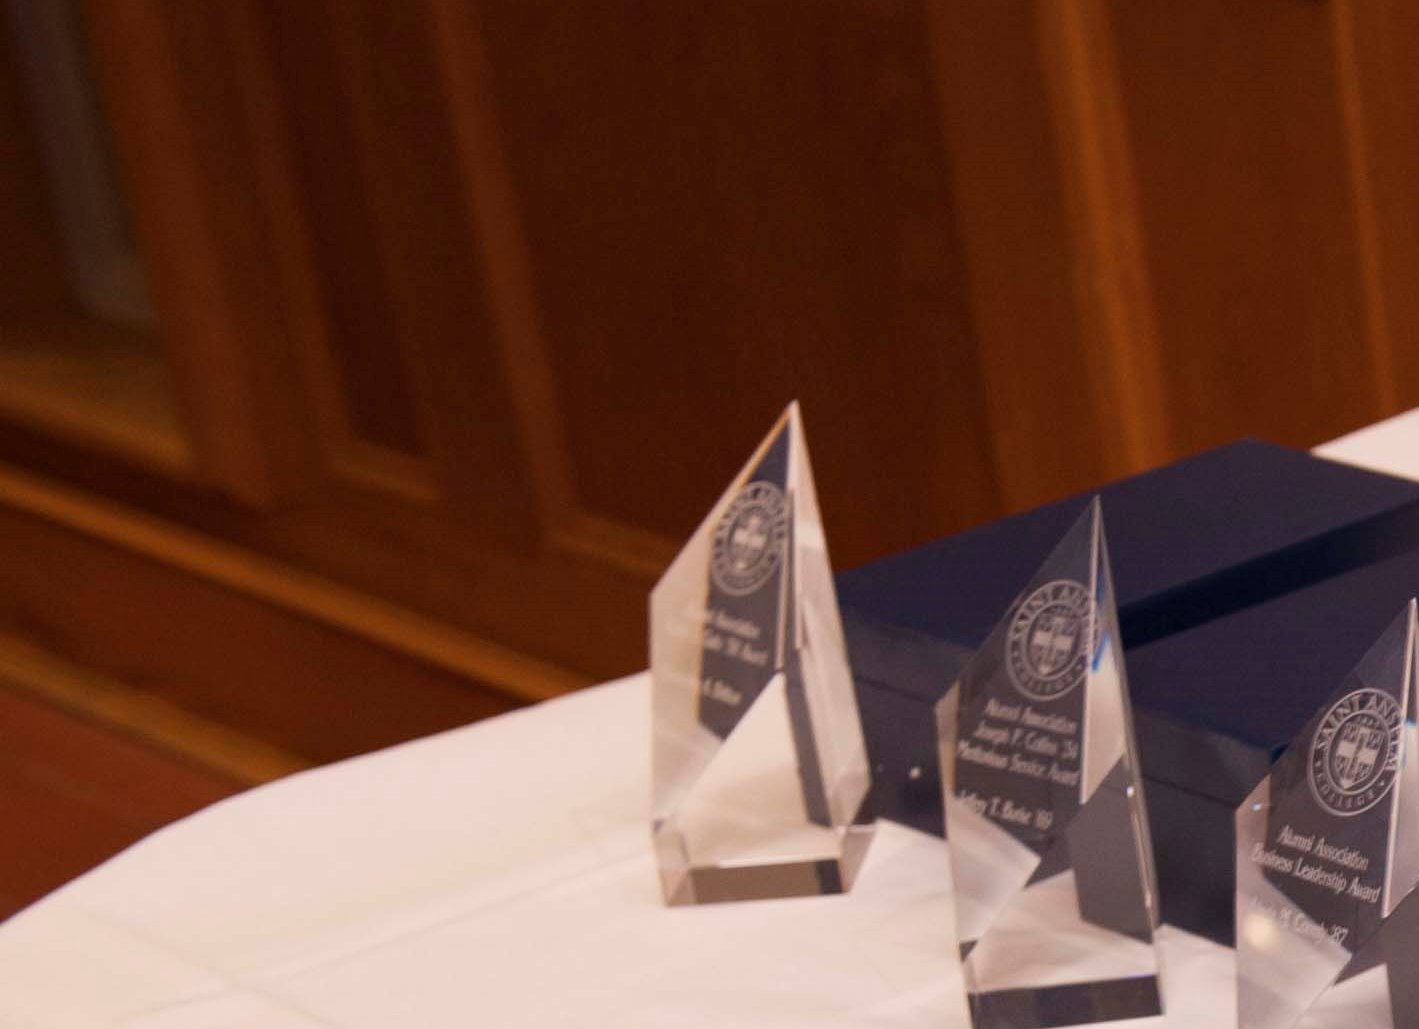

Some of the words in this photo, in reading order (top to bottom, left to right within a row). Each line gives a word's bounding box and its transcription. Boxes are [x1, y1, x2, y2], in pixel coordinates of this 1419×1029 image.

[1277, 825, 1315, 851] Alumni
[1315, 837, 1370, 871] Association
[1294, 858, 1348, 895] Leadership
[1350, 874, 1383, 903] Award
